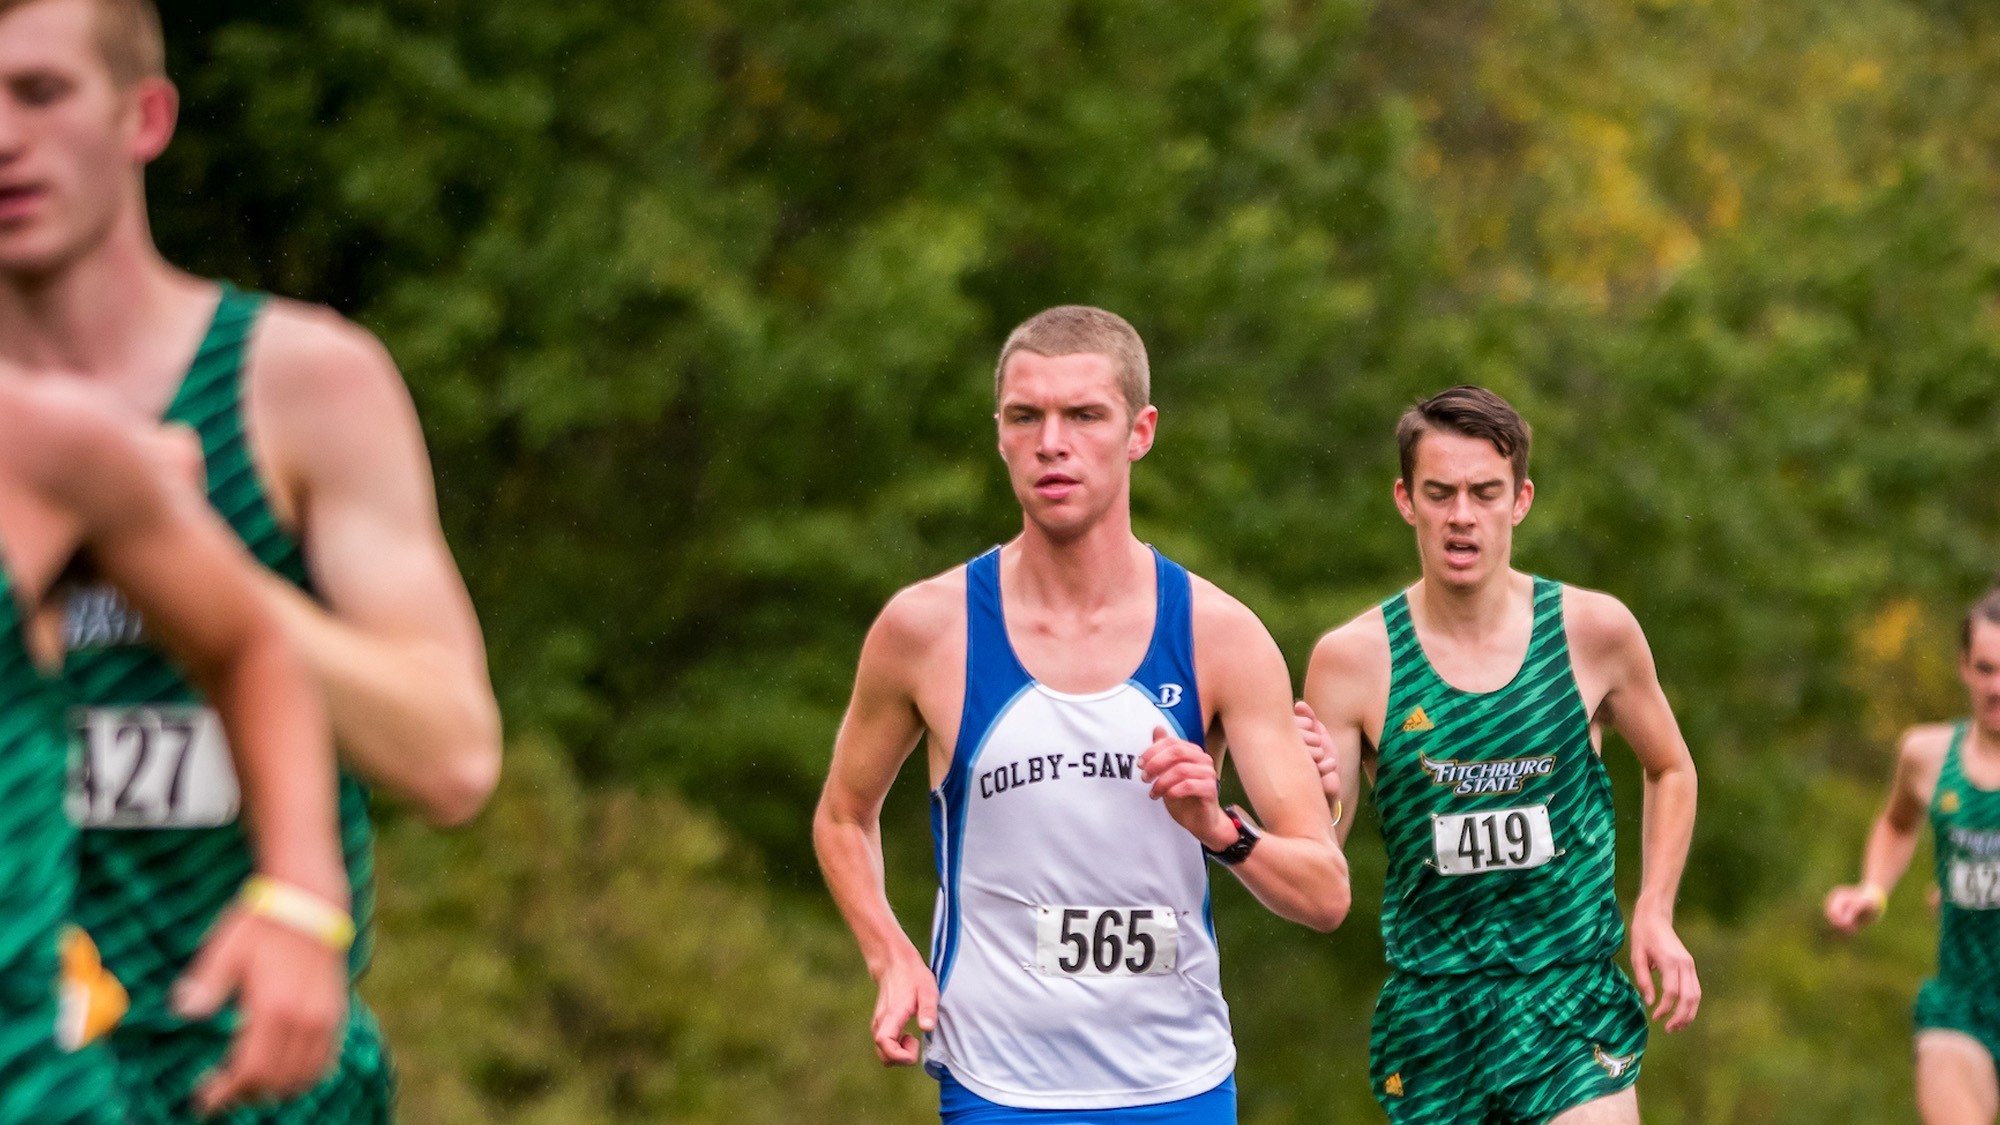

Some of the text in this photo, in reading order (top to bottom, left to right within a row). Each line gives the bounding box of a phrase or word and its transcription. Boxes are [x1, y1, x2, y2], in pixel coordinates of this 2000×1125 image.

[979, 752, 1142, 800] COLBY-SAW
[1424, 758, 1553, 783] FITCHBURG
[1456, 776, 1523, 795] STATE
[1457, 811, 1533, 869] 419
[1058, 908, 1154, 974] 565
